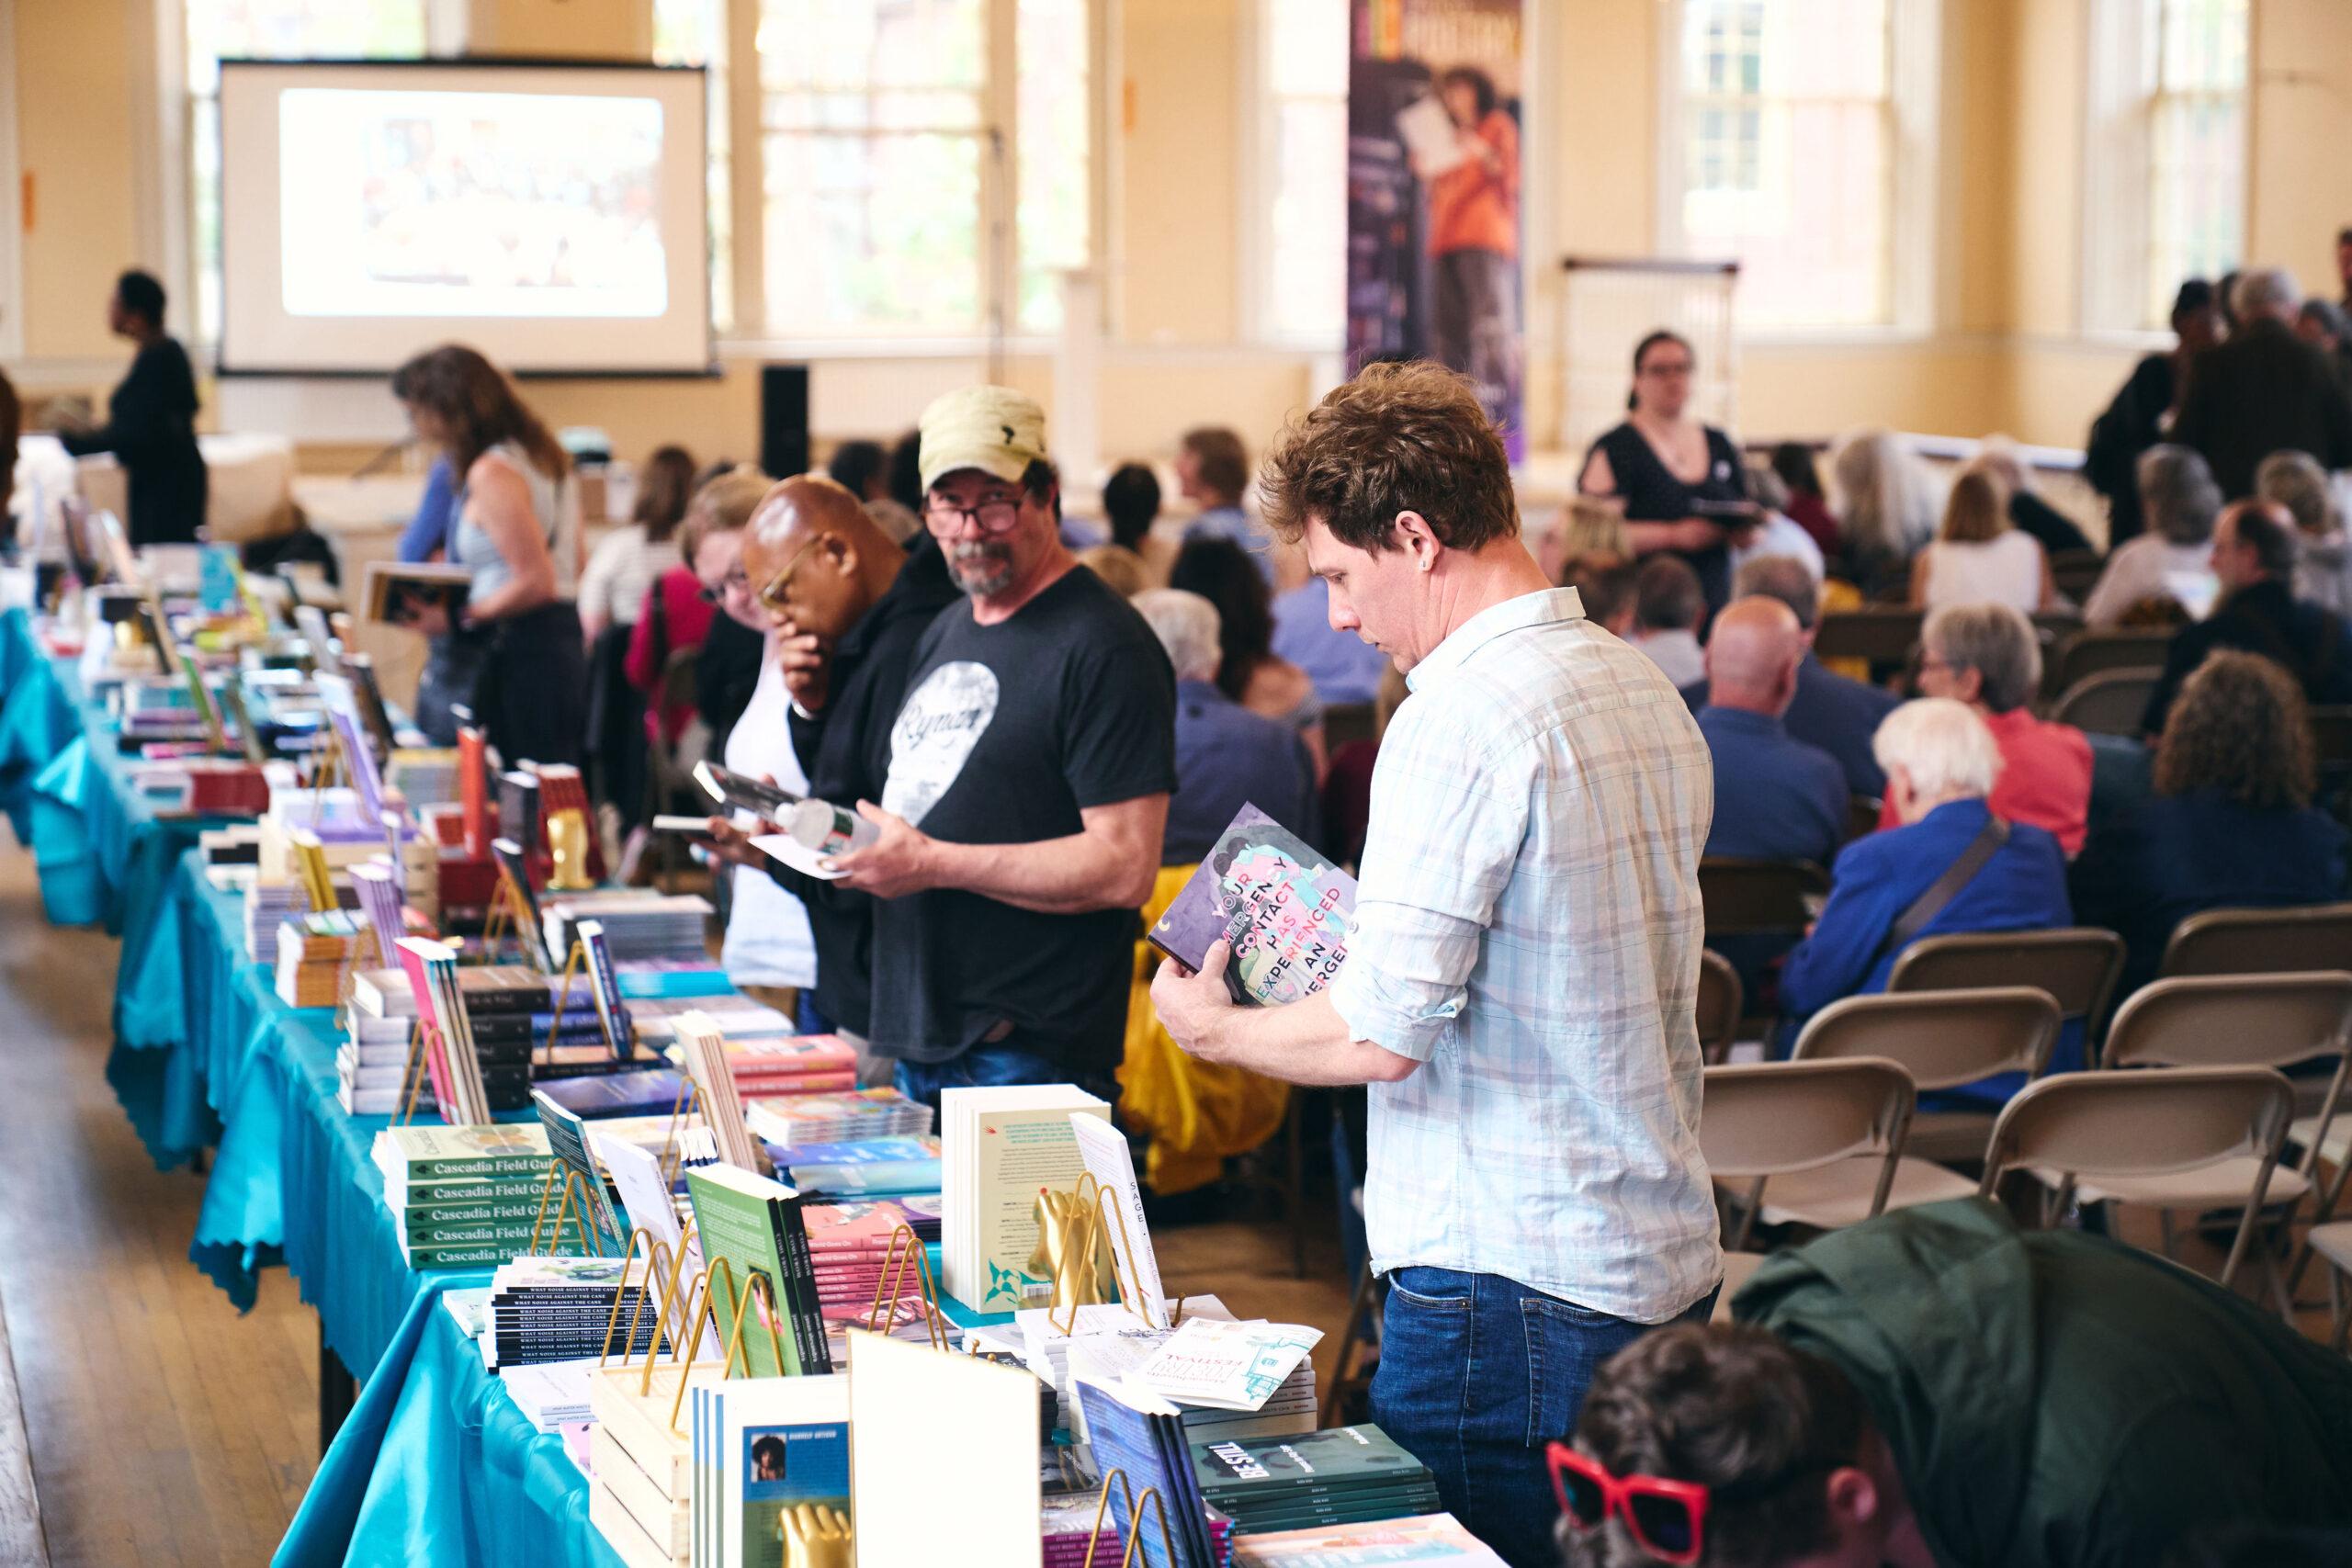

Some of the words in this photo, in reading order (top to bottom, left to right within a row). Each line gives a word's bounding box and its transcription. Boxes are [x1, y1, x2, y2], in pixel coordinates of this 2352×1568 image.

[1212, 873, 1252, 918] YOUR
[1236, 881, 1295, 959] CONTACT
[1267, 915, 1296, 949] HAS
[1256, 888, 1340, 999] EXPERIENCED
[1305, 942, 1326, 969] AN
[434, 1160, 493, 1174] Cascadia
[496, 1159, 527, 1172] Field
[530, 1159, 554, 1170] Gui
[434, 1185, 493, 1199] Cascadia
[496, 1184, 527, 1196] Field
[432, 1207, 491, 1220] Cascadia
[493, 1205, 525, 1218] Field
[1131, 1182, 1144, 1223] SAGE
[434, 1228, 493, 1241] Cascadia
[496, 1226, 528, 1238] Field
[437, 1249, 496, 1262] Cascadia
[499, 1247, 530, 1258] Field
[1166, 1354, 1242, 1366] FESTIVAL
[1208, 1441, 1255, 1465] STILL
[1232, 1463, 1270, 1479] BE
